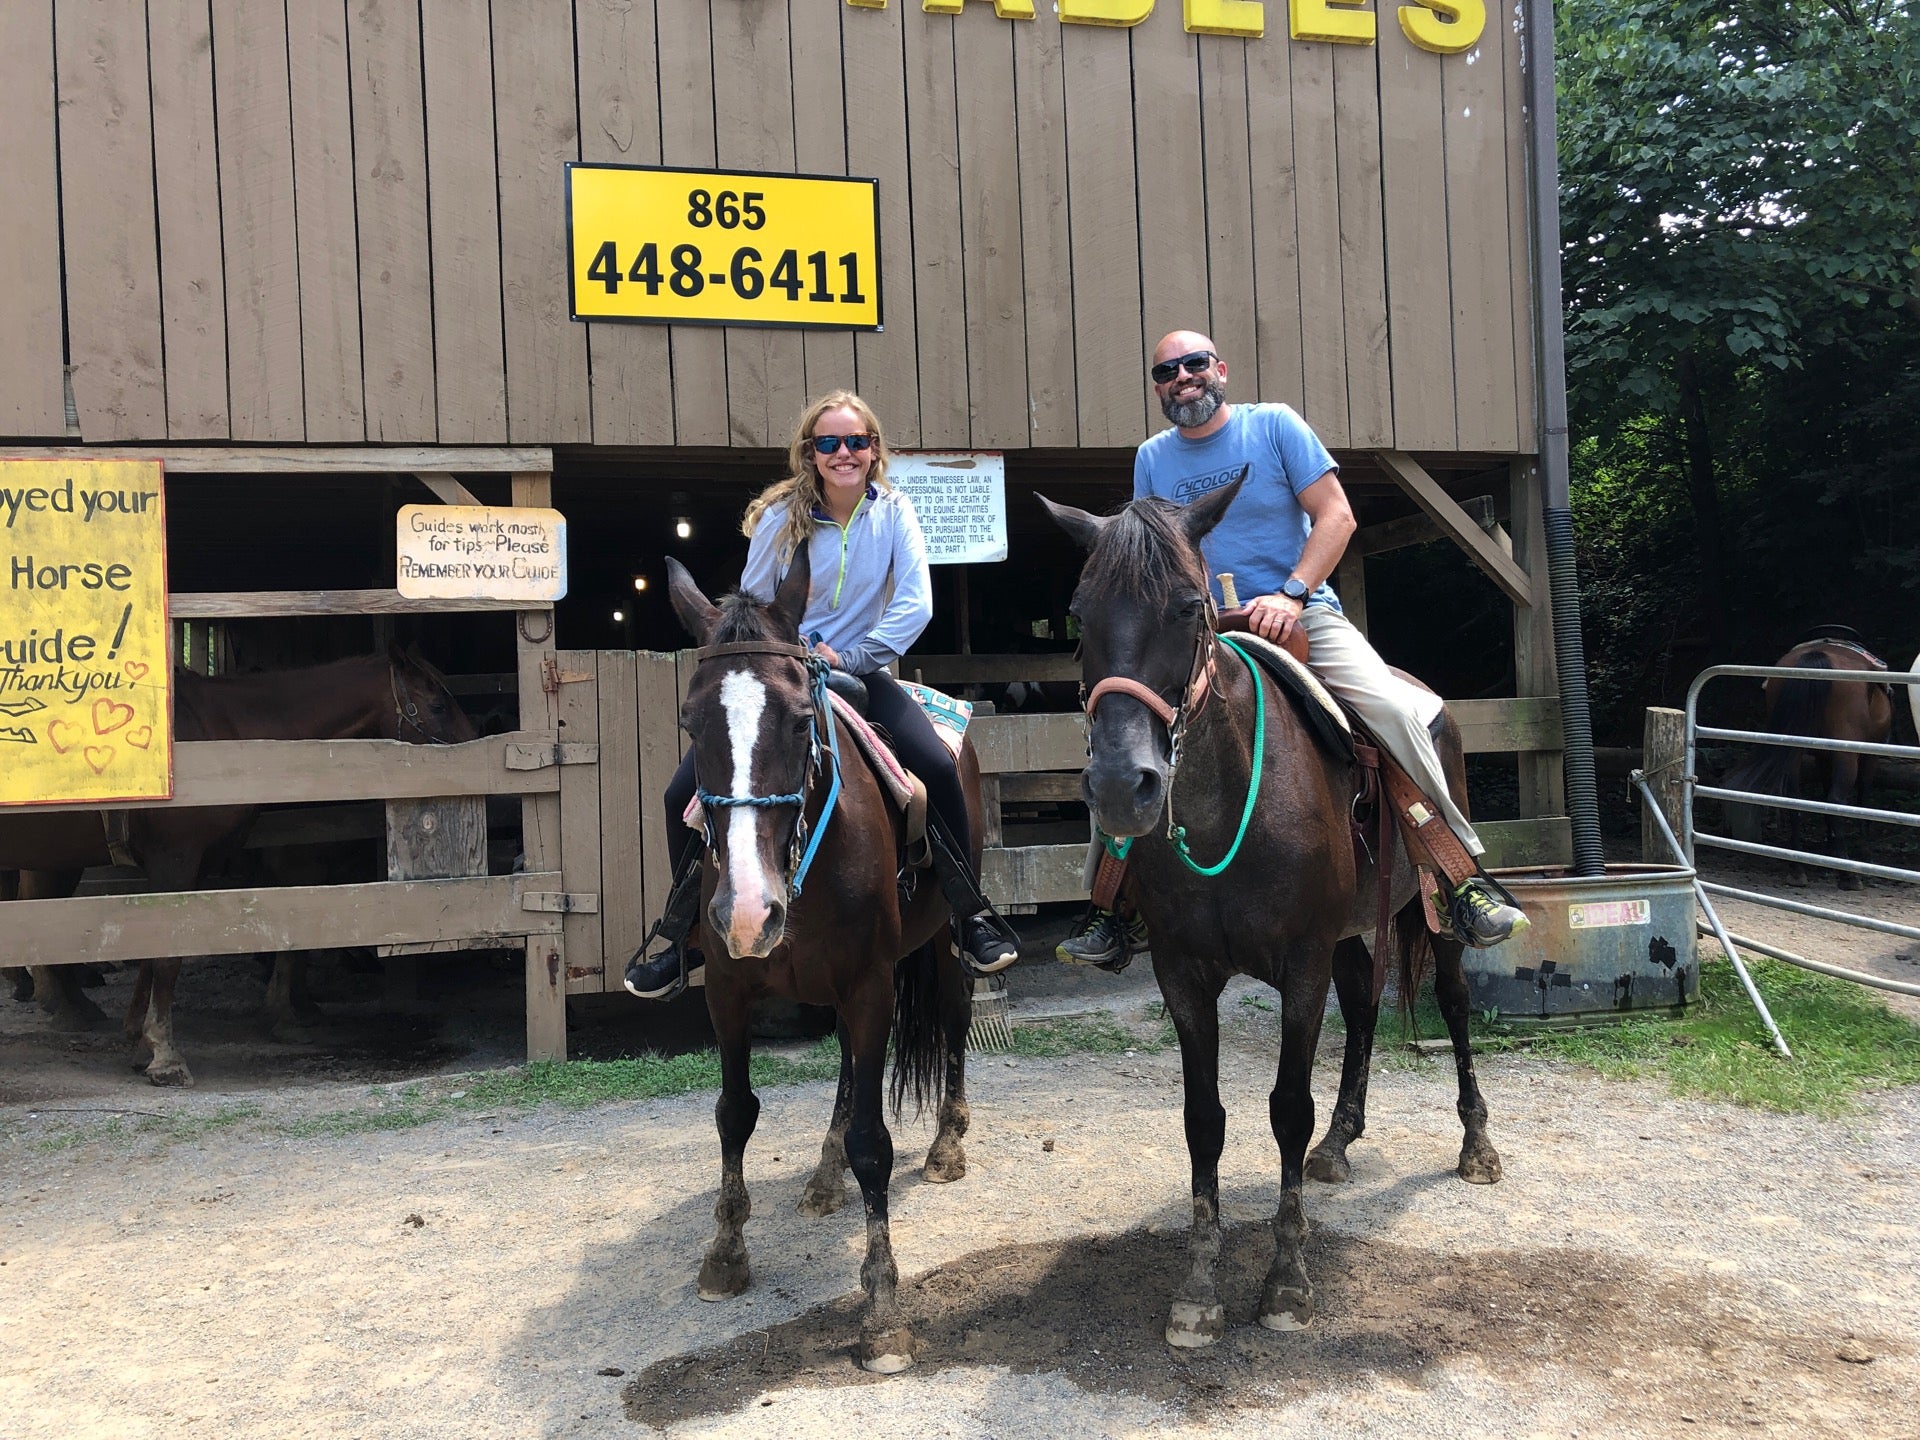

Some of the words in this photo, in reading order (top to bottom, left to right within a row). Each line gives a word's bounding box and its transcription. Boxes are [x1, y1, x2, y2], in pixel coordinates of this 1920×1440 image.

[687, 189, 766, 231] 865
[587, 241, 865, 304] 448-6411
[907, 475, 927, 484] UNDER
[930, 475, 965, 484] TENNESSEE
[984, 475, 992, 484] AN
[899, 485, 944, 495] PROFESSIONAL
[946, 485, 953, 494] IS
[955, 485, 967, 494] NOT
[80, 490, 159, 522] your
[909, 495, 922, 505] URY
[924, 495, 933, 504] TO
[935, 495, 944, 504] OR
[947, 495, 958, 504] THE
[961, 495, 980, 504] DEATH
[982, 495, 991, 503] OF
[914, 505, 922, 514] NT
[925, 505, 931, 514] IN
[934, 505, 955, 514] EQUINE
[958, 505, 989, 513] ACTIVITIES
[411, 512, 463, 533] Guides
[469, 519, 504, 533] work
[926, 515, 938, 524] THE
[940, 515, 969, 524] INHERENT
[972, 515, 986, 523] RISK
[988, 515, 996, 523] OF
[920, 525, 933, 534] TIES
[936, 525, 967, 534] PURSUANT
[969, 525, 978, 533] TO
[980, 525, 992, 533] THE
[429, 535, 450, 552] for
[455, 537, 483, 555] tips
[496, 534, 550, 554] Please
[931, 535, 967, 545] ANNOTATED,
[969, 535, 985, 543] TITLE
[946, 544, 961, 554] PART
[11, 555, 132, 591] Horse
[400, 555, 471, 579] REMEMBER
[473, 563, 510, 579] YOUR
[0, 602, 133, 665] uide!
